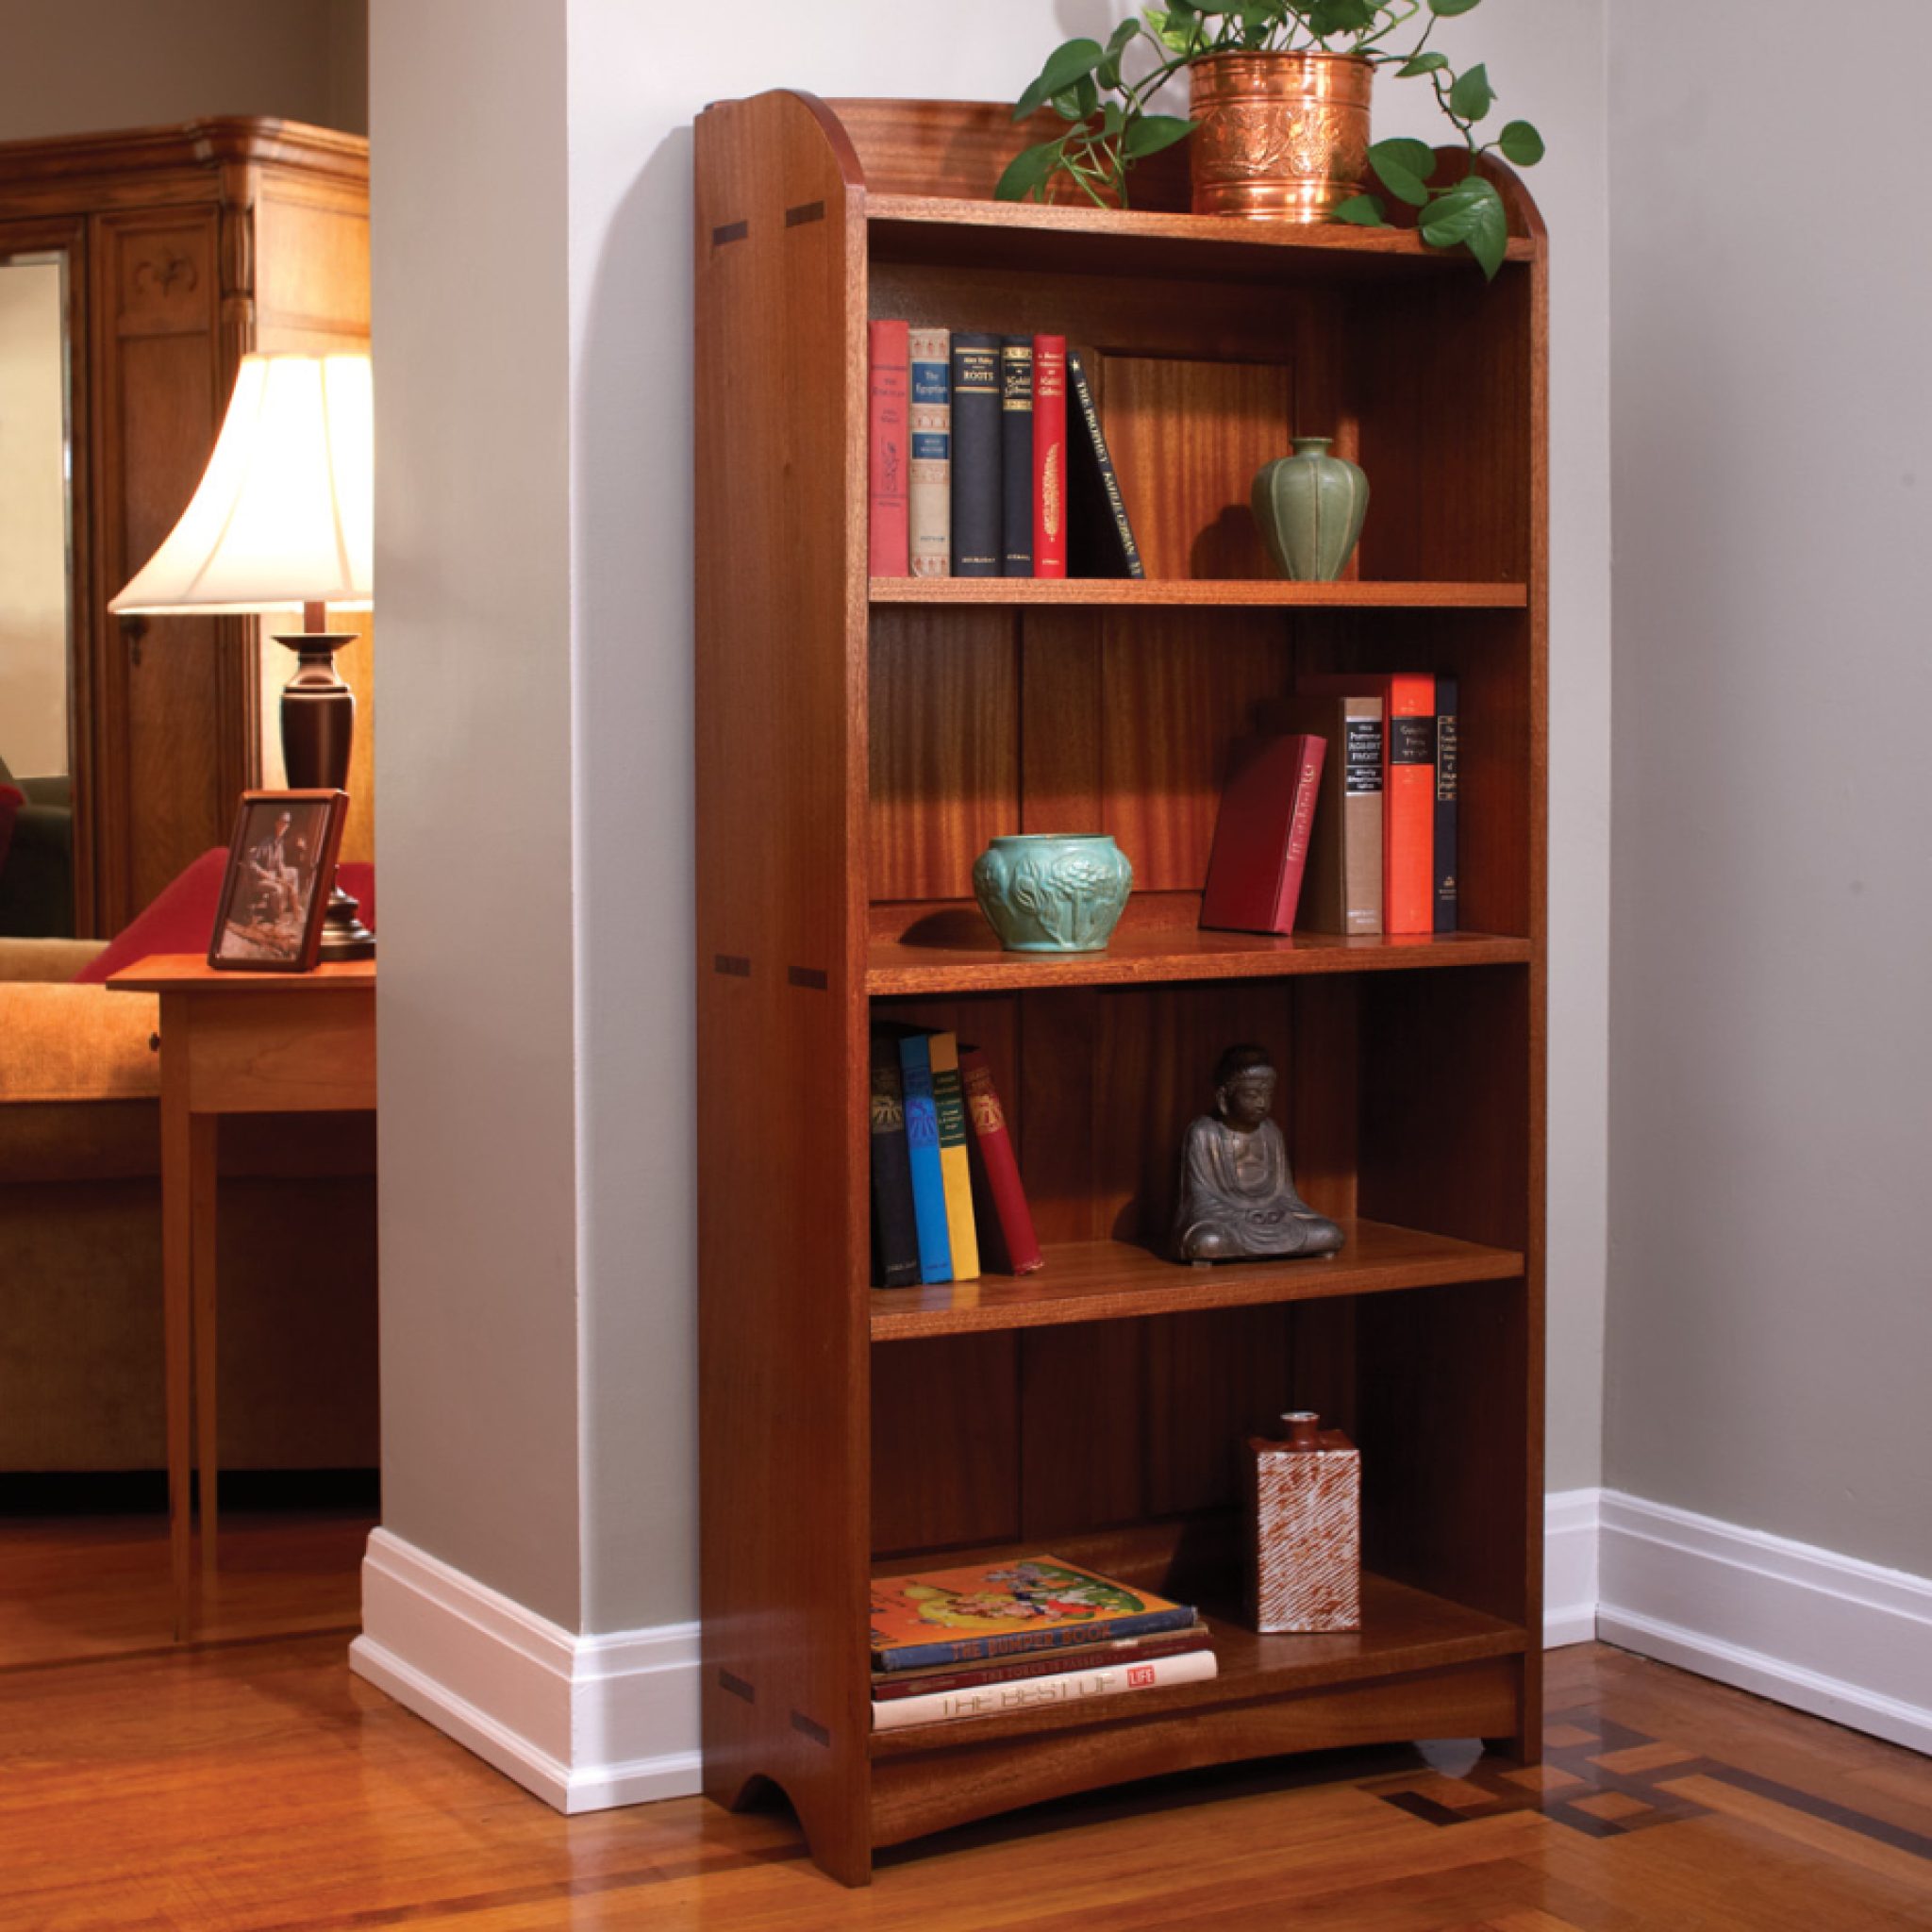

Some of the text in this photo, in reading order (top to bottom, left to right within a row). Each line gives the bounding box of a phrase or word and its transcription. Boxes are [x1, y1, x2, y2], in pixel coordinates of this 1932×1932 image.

[952, 1641, 981, 1661] THE
[1062, 1624, 1111, 1645] BOOK
[1128, 1667, 1154, 1686] LIFE
